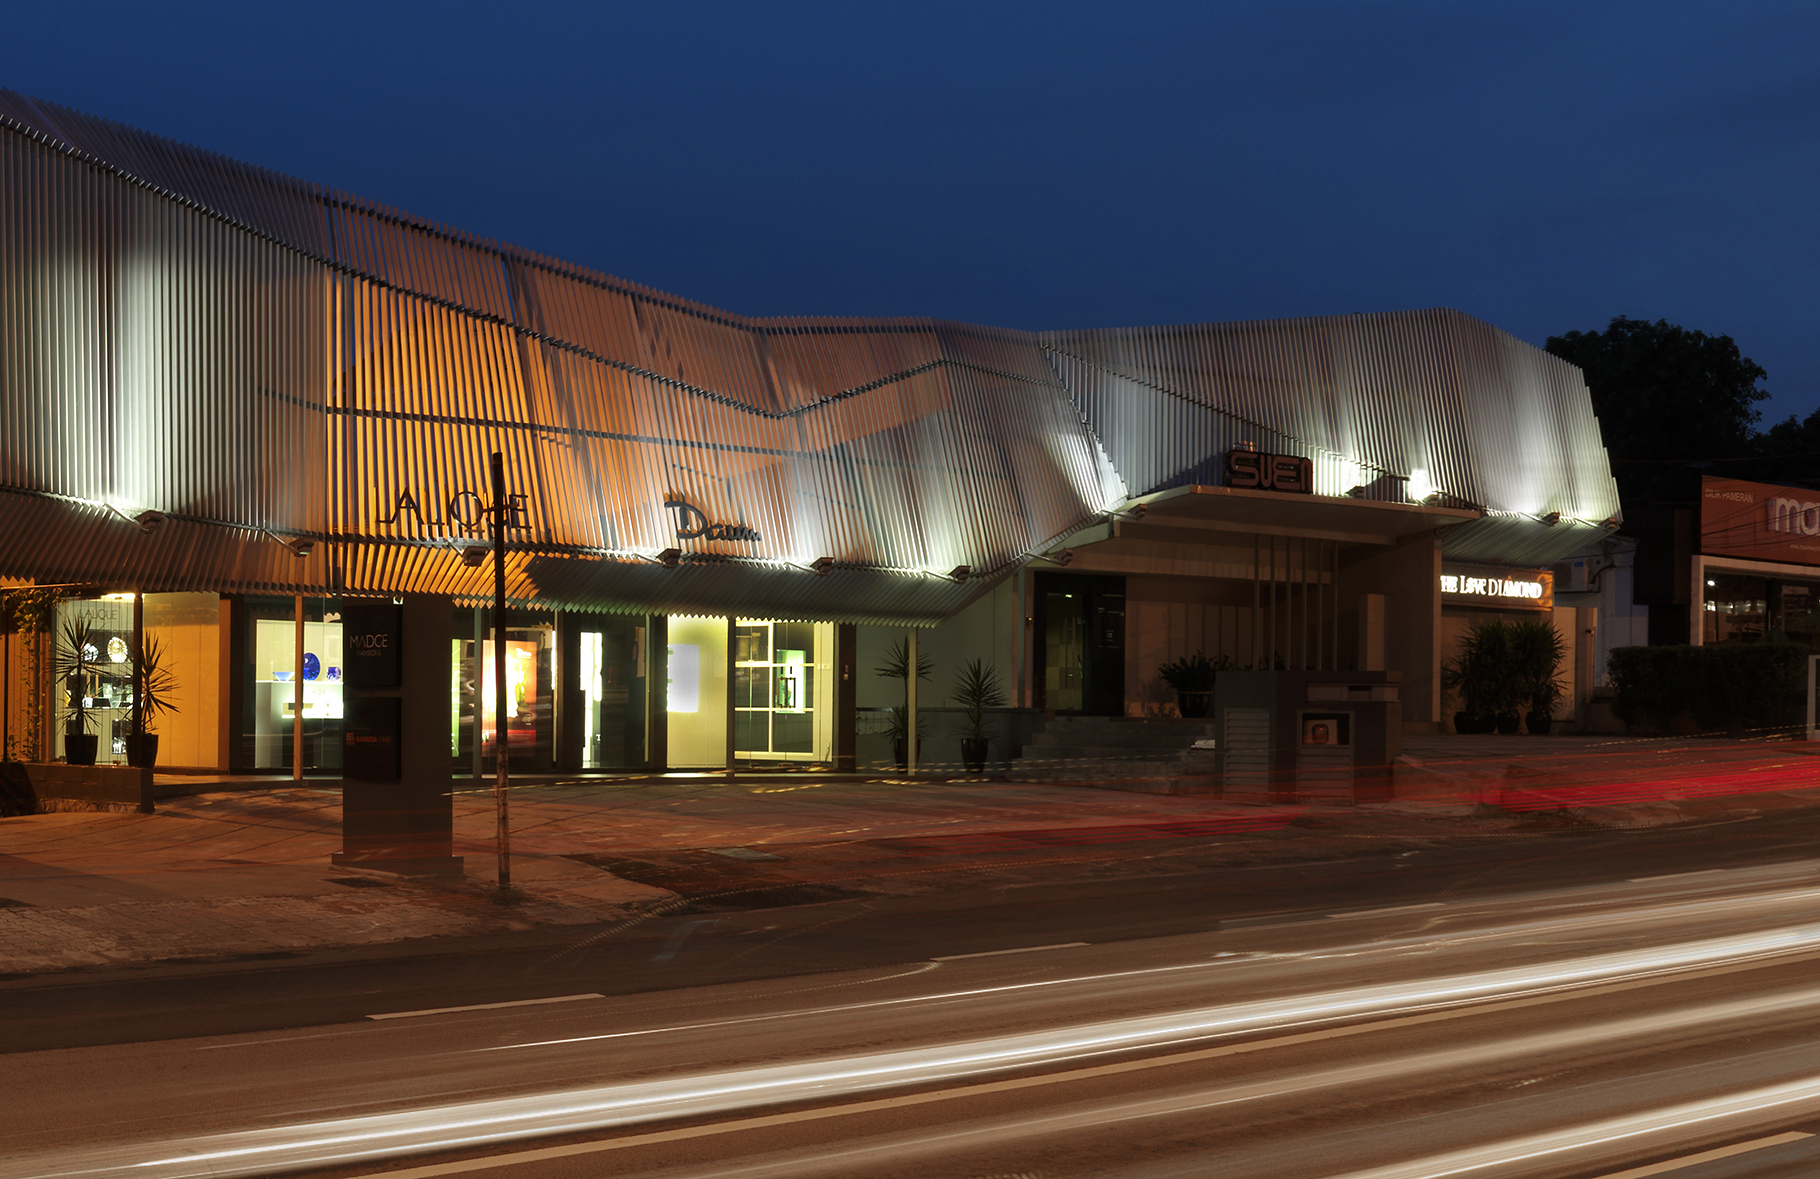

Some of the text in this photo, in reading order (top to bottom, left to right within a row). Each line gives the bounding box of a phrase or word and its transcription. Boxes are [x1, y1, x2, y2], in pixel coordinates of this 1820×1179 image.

[1722, 491, 1754, 503] PAMERAN
[664, 500, 762, 542] Daum
[1488, 579, 1542, 599] DIAMOND
[79, 608, 118, 621] LALIQUE
[349, 633, 388, 648] MADGE
[356, 649, 382, 657] MANSIONS
